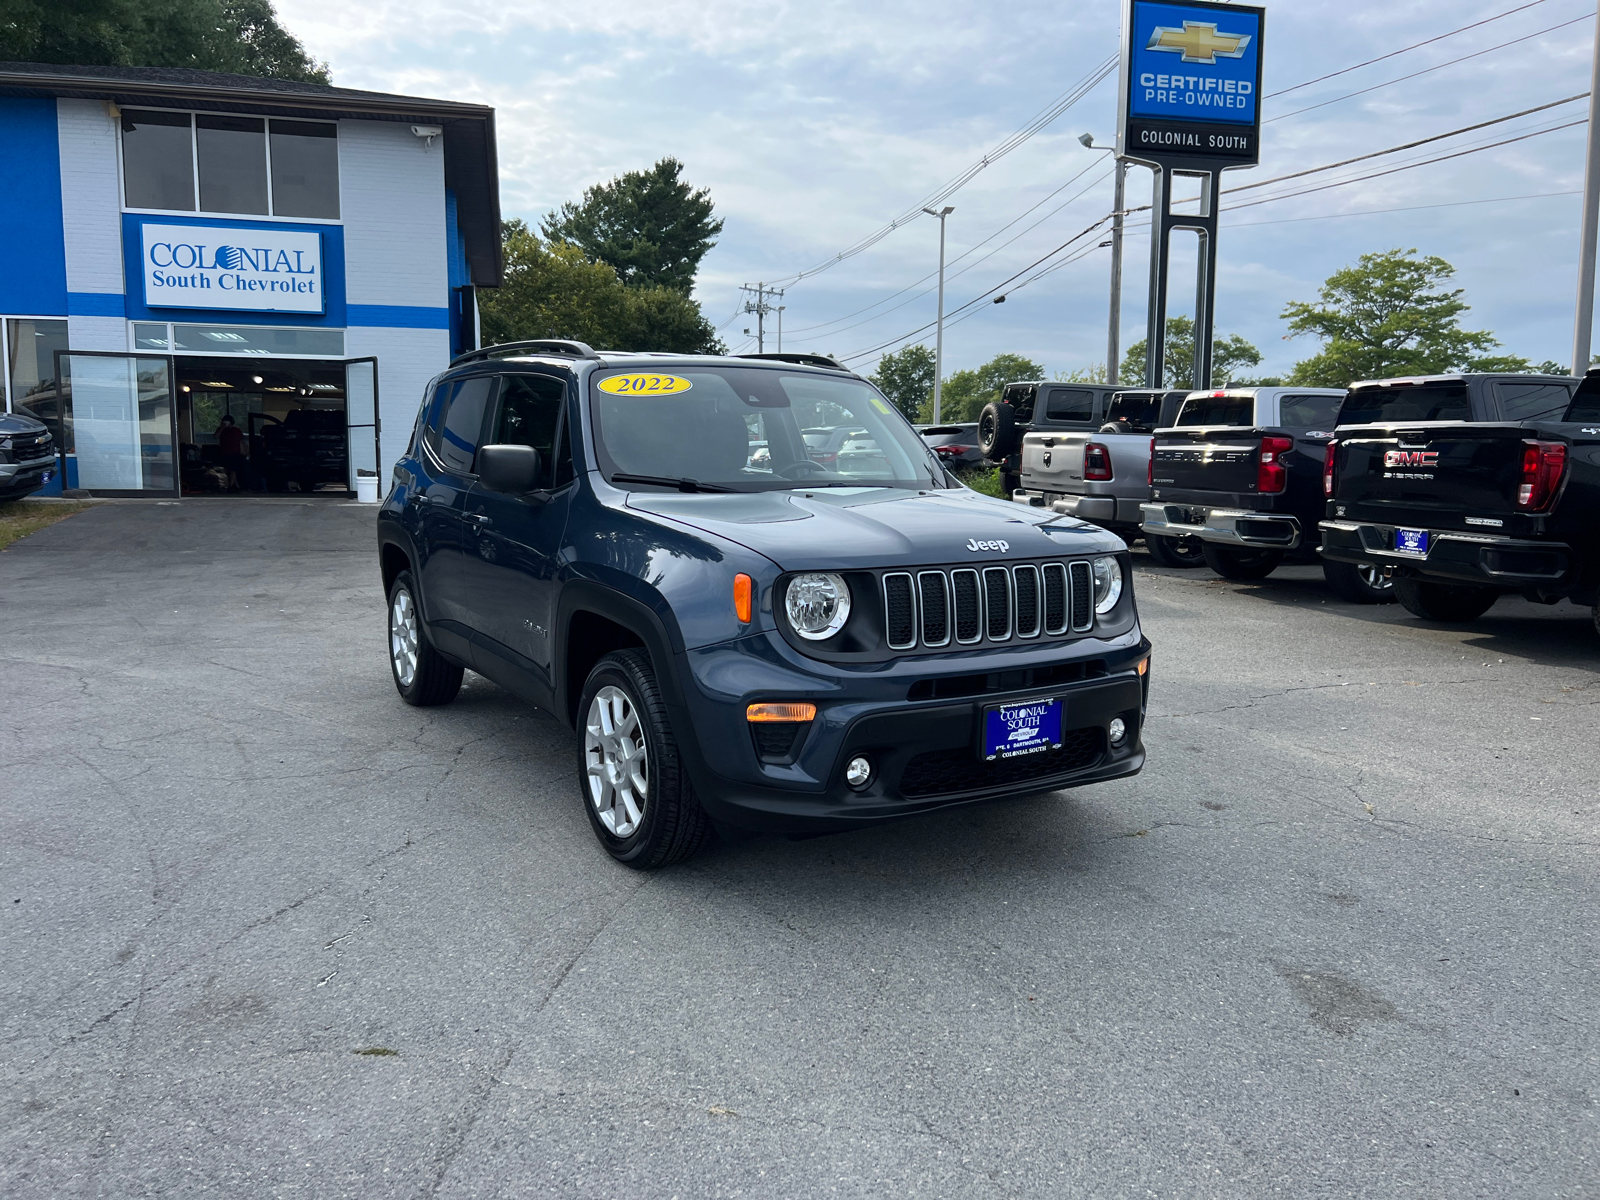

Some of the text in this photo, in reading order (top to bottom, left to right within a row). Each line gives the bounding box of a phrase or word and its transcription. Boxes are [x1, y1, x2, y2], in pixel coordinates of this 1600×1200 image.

[1140, 73, 1252, 95] CERTIFIED
[1145, 89, 1246, 109] PRE-OWNED
[1141, 130, 1247, 149] COLONIAL SOUTH
[150, 242, 315, 274] COLONIAL
[152, 270, 315, 294] South Chevrolet
[616, 377, 675, 392] 2022
[1383, 450, 1439, 467] GMC
[966, 538, 1010, 554] Jeep
[1000, 705, 1048, 721] COLONIAL
[1007, 715, 1040, 730] SOUTH
[1011, 730, 1036, 738] CHEVROLET
[1002, 745, 1047, 758] COLONIAL SOUTH
